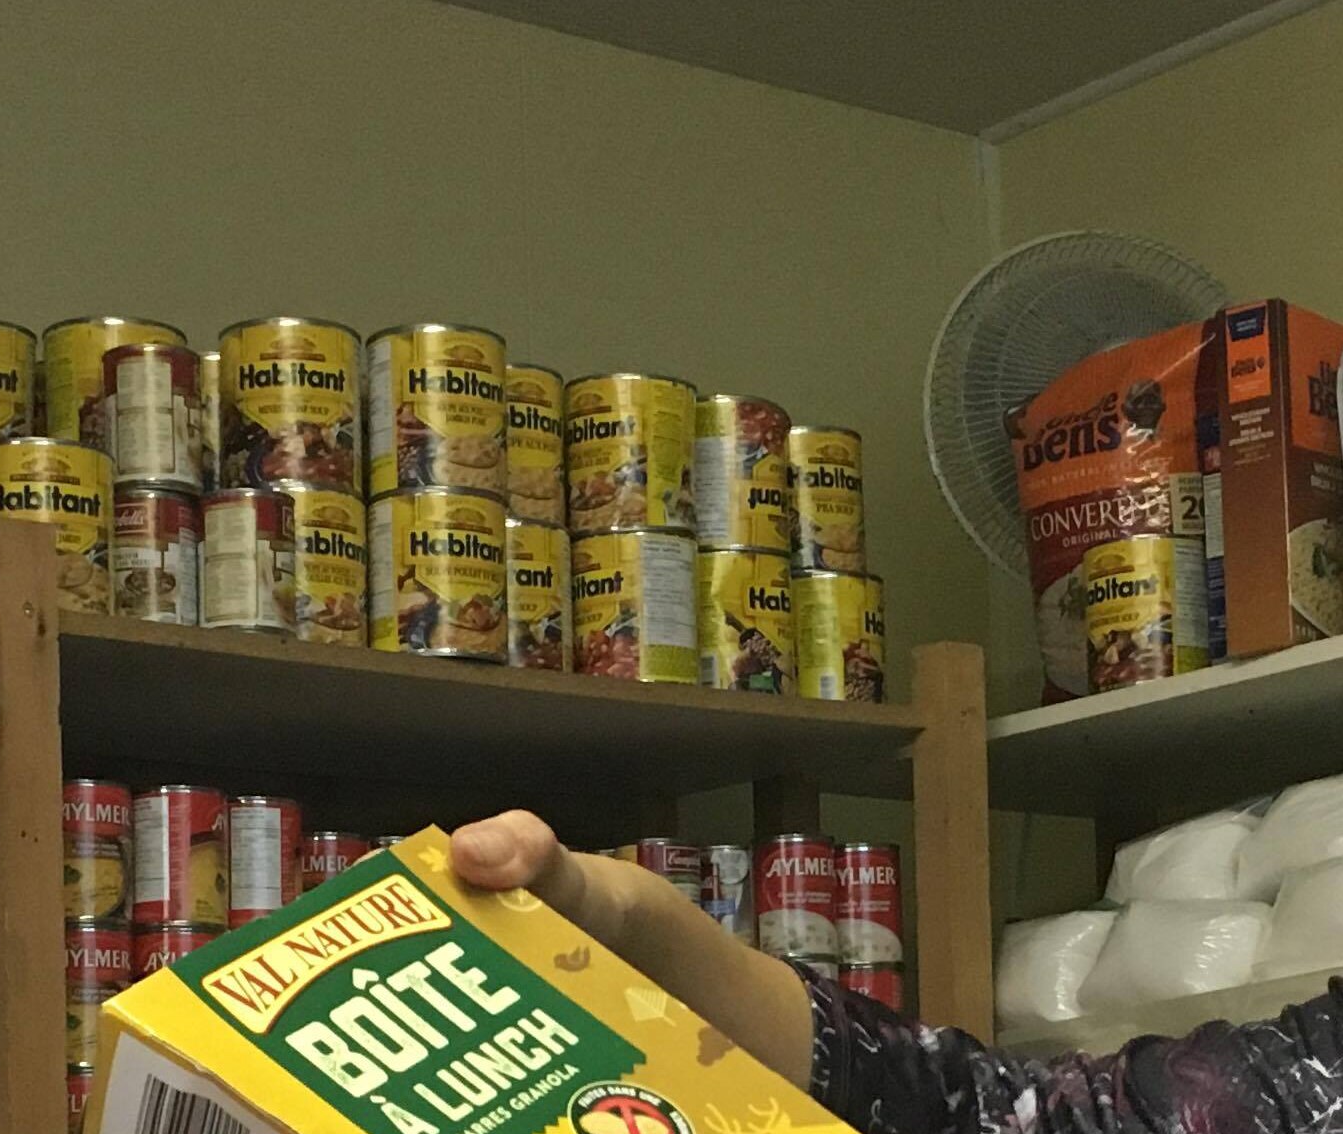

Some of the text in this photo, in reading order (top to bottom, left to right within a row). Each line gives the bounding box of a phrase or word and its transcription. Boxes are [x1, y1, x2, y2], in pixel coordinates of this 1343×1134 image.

[239, 364, 345, 392] Habitant
[409, 368, 503, 399] Habitan
[509, 405, 561, 438] bitan
[787, 465, 862, 492] Habitan
[302, 531, 367, 563] abitan
[410, 532, 503, 564] Habitan
[1062, 529, 1119, 548] ORIGINAL
[302, 854, 348, 873] LMER
[766, 857, 835, 879] AYLMER
[836, 866, 897, 886] YLMER
[65, 949, 131, 971] YLMER
[210, 880, 437, 1017] VAL NATURE
[285, 941, 520, 1098] BOÎTE
[414, 1008, 579, 1122] LUNCH
[510, 1065, 581, 1112] GRANOLA
